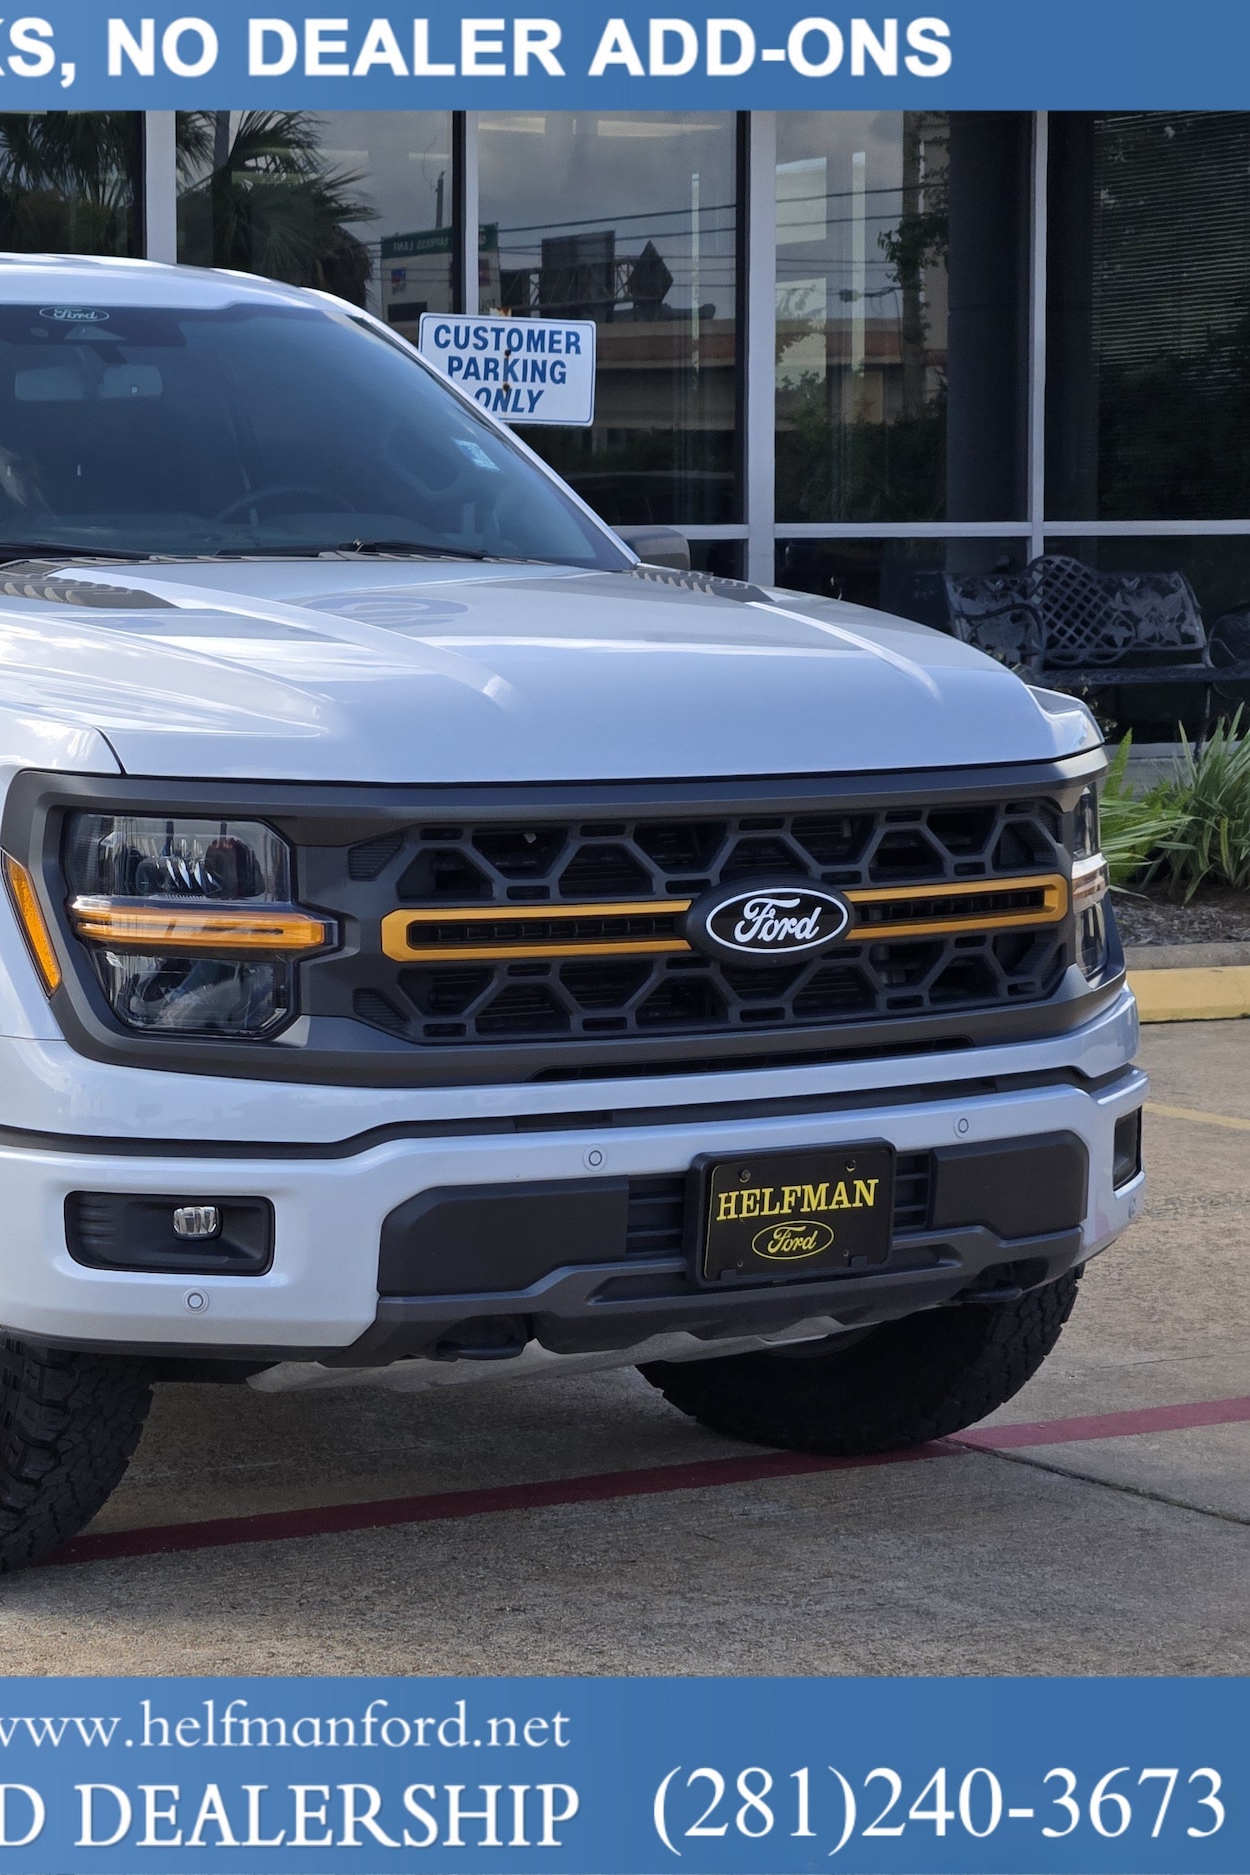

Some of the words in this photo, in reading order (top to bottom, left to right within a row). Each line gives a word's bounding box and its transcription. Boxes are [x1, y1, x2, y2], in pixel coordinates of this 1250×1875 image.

[53, 308, 98, 320] Ford
[434, 324, 582, 355] CUSTOMER
[448, 356, 567, 385] PARKING
[474, 387, 544, 413] ONLY
[734, 897, 822, 943] Ford
[716, 1178, 880, 1222] HELFMAN
[767, 1225, 819, 1254] Ford
